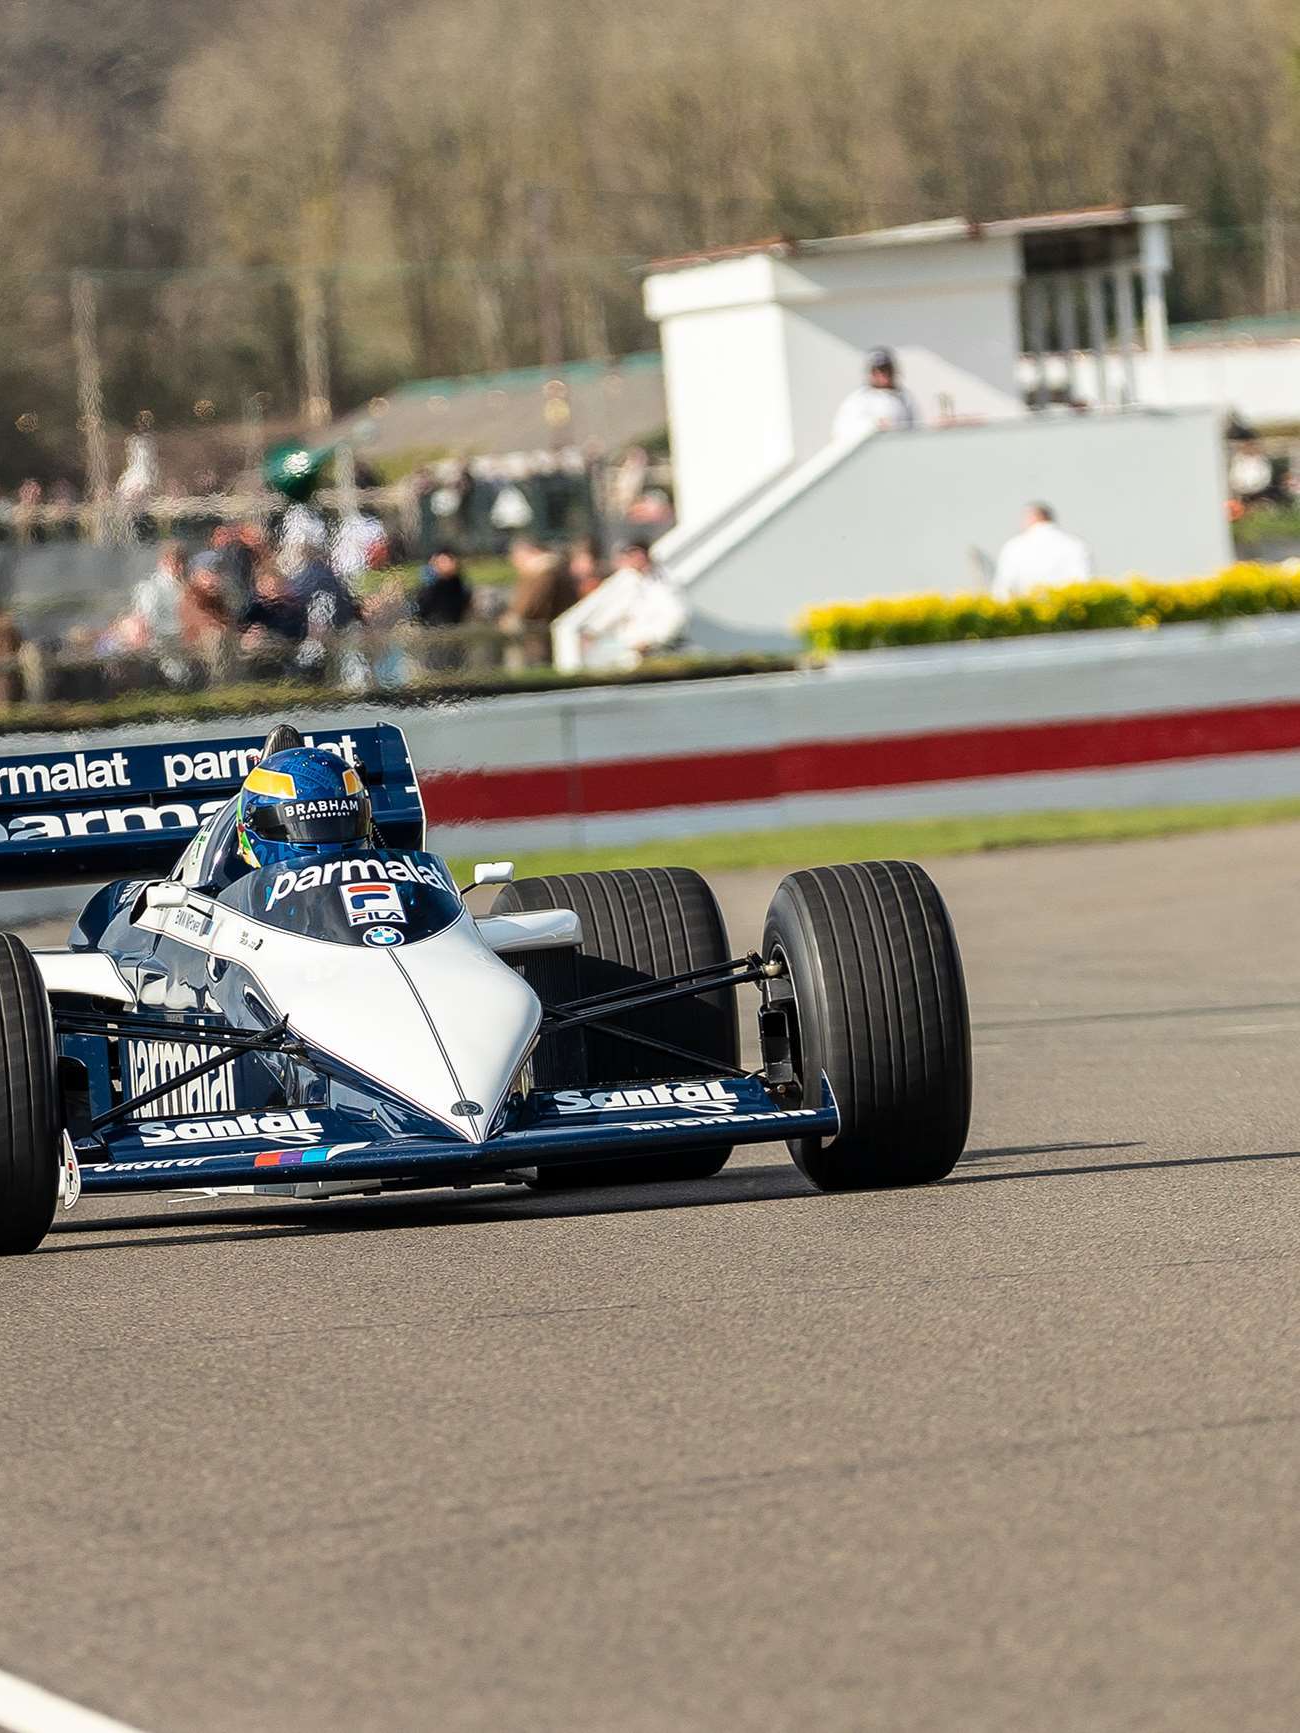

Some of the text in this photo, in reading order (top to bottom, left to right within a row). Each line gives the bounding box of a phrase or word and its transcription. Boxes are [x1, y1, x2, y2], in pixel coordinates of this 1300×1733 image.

[284, 800, 359, 817] BRABHAM
[299, 811, 351, 821] MOTORSPORT
[265, 855, 457, 912] parmalat
[352, 911, 403, 923] FILA
